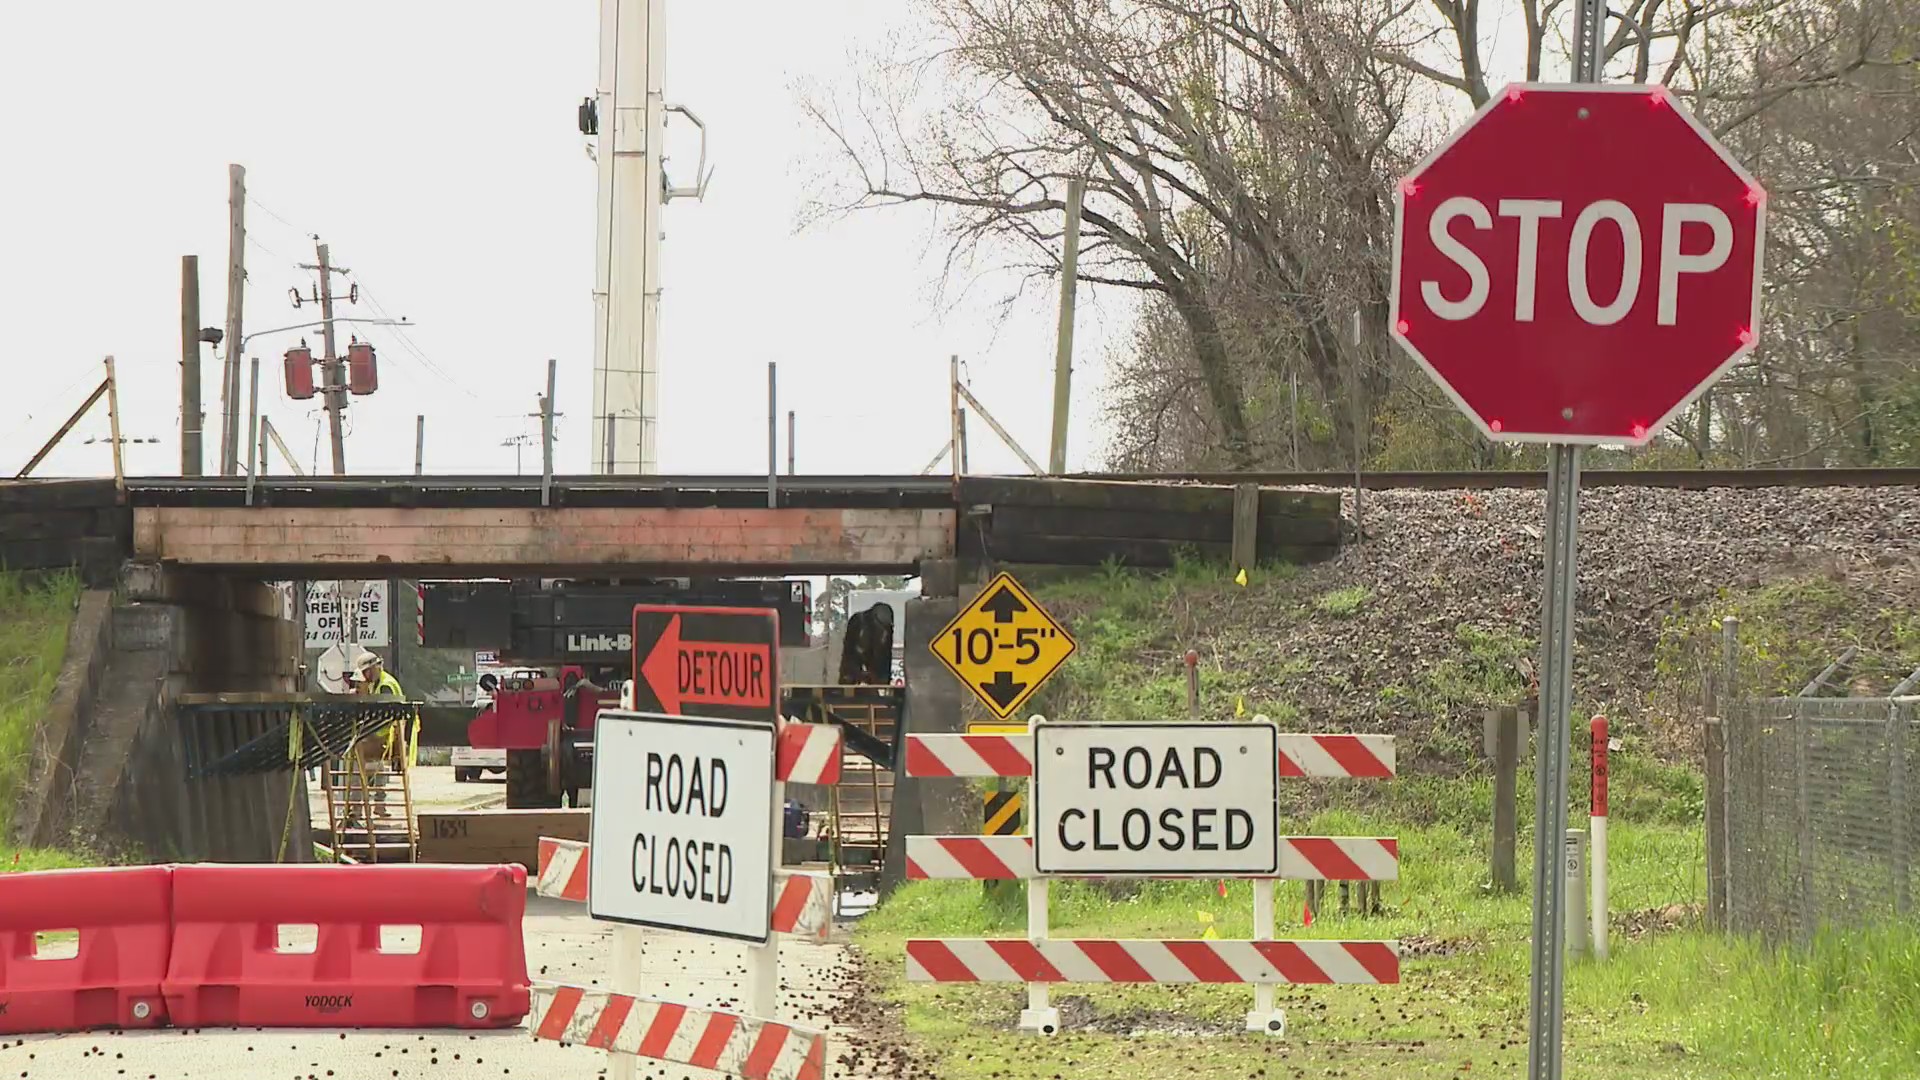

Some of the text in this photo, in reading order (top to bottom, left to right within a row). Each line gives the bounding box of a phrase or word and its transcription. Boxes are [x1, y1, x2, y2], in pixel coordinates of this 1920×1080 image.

[1421, 196, 1733, 326] STOP
[952, 627, 1055, 665] 10'-5"
[678, 650, 765, 699] DETOUR
[646, 752, 728, 818] ROAD
[1088, 746, 1222, 789] ROAD
[1058, 808, 1254, 851] CLOSED
[632, 832, 732, 904] CLOSED
[304, 995, 353, 1008] YODOCK
